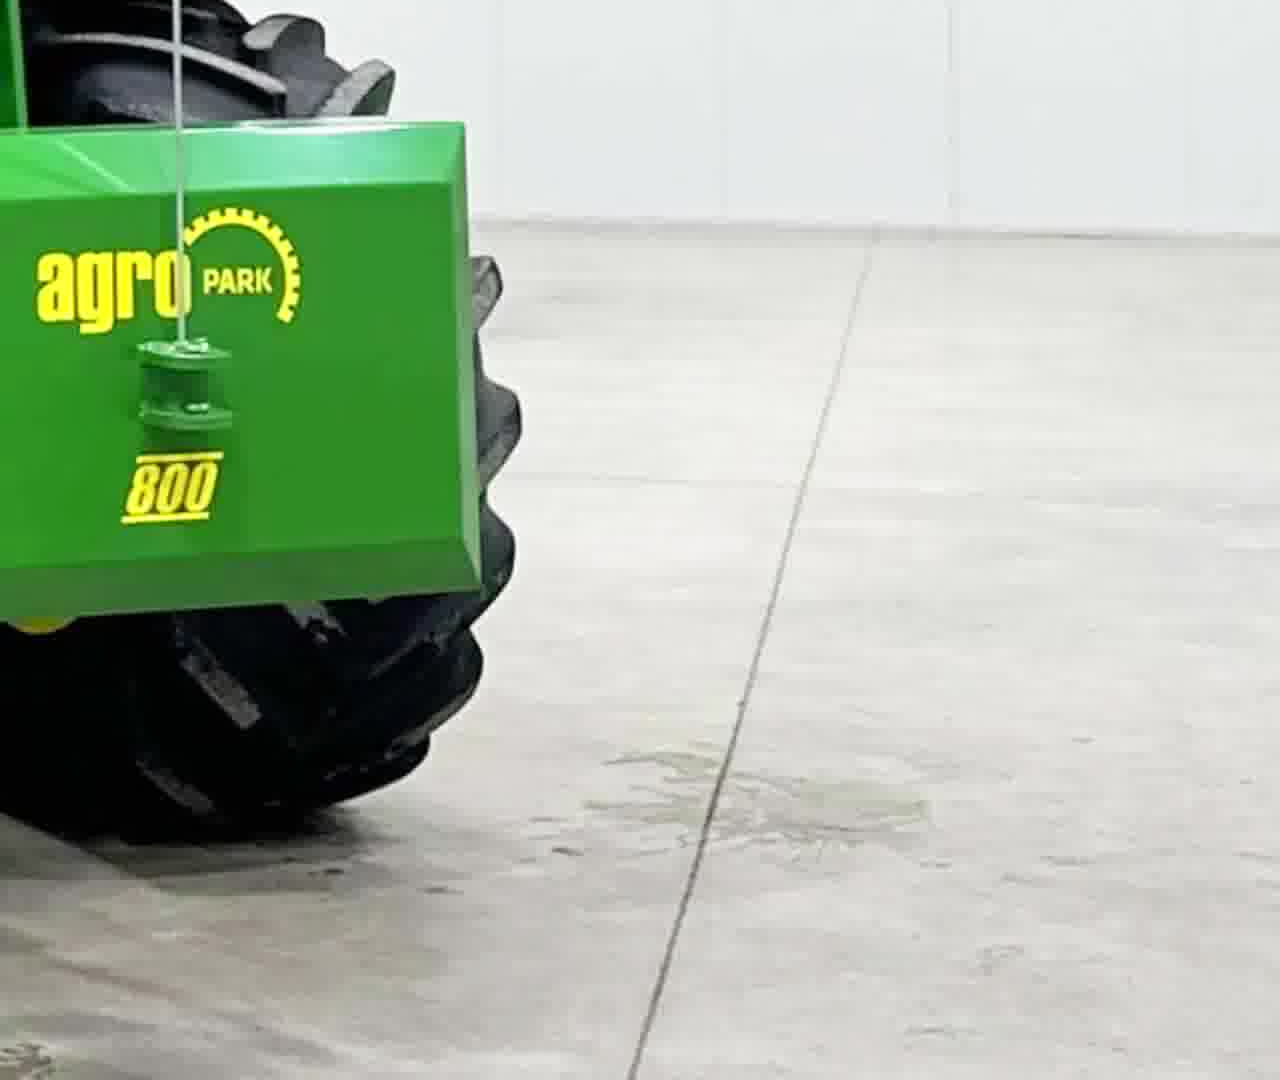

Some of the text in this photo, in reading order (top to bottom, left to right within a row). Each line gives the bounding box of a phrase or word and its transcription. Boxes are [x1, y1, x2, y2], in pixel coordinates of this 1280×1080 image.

[36, 249, 274, 334] agro PARK
[124, 461, 219, 516] 800
